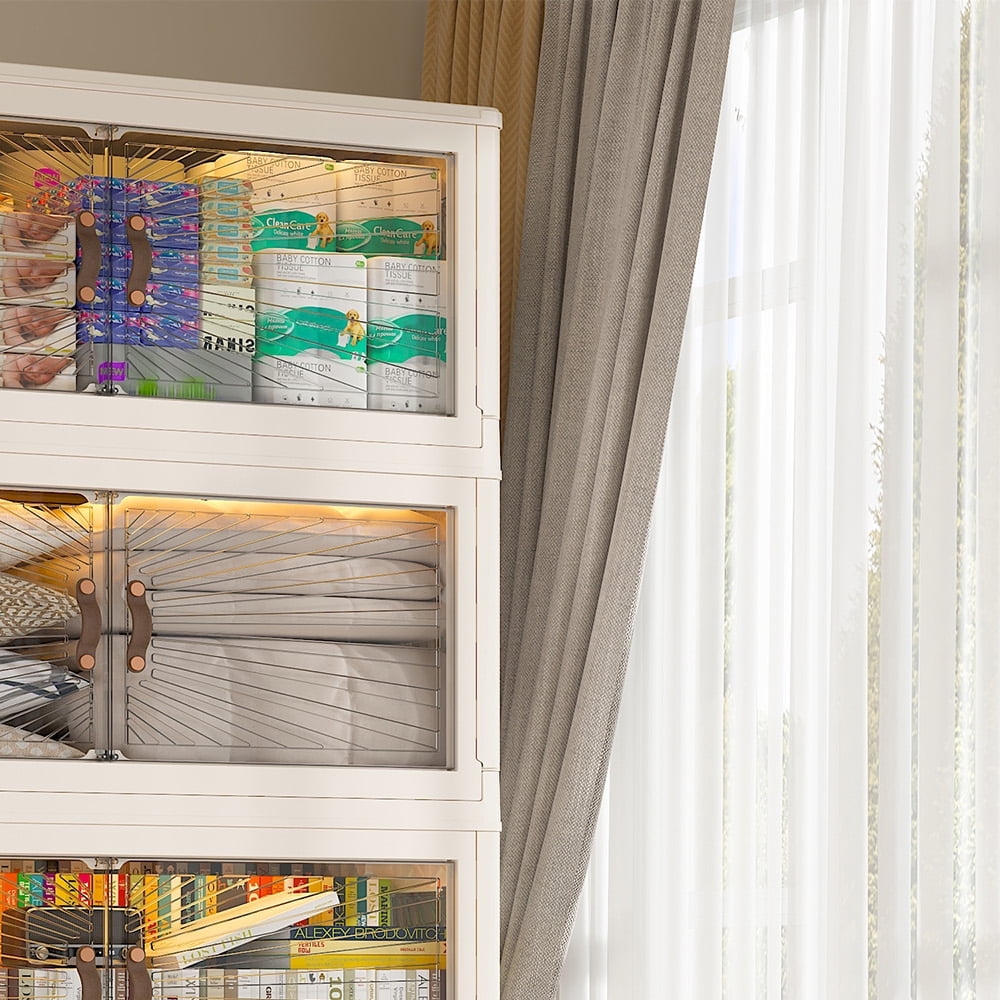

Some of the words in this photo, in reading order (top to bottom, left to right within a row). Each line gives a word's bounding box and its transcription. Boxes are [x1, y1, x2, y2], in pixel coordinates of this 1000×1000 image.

[377, 168, 407, 178] COTTON
[266, 217, 312, 231] CleanCare
[276, 255, 298, 264] BABY
[300, 256, 332, 266] COTTON
[385, 262, 407, 271] BABY
[386, 270, 413, 280] TISSUE
[385, 368, 407, 377] BABY
[294, 927, 351, 940] ALEXEY
[182, 943, 218, 965] LOST
